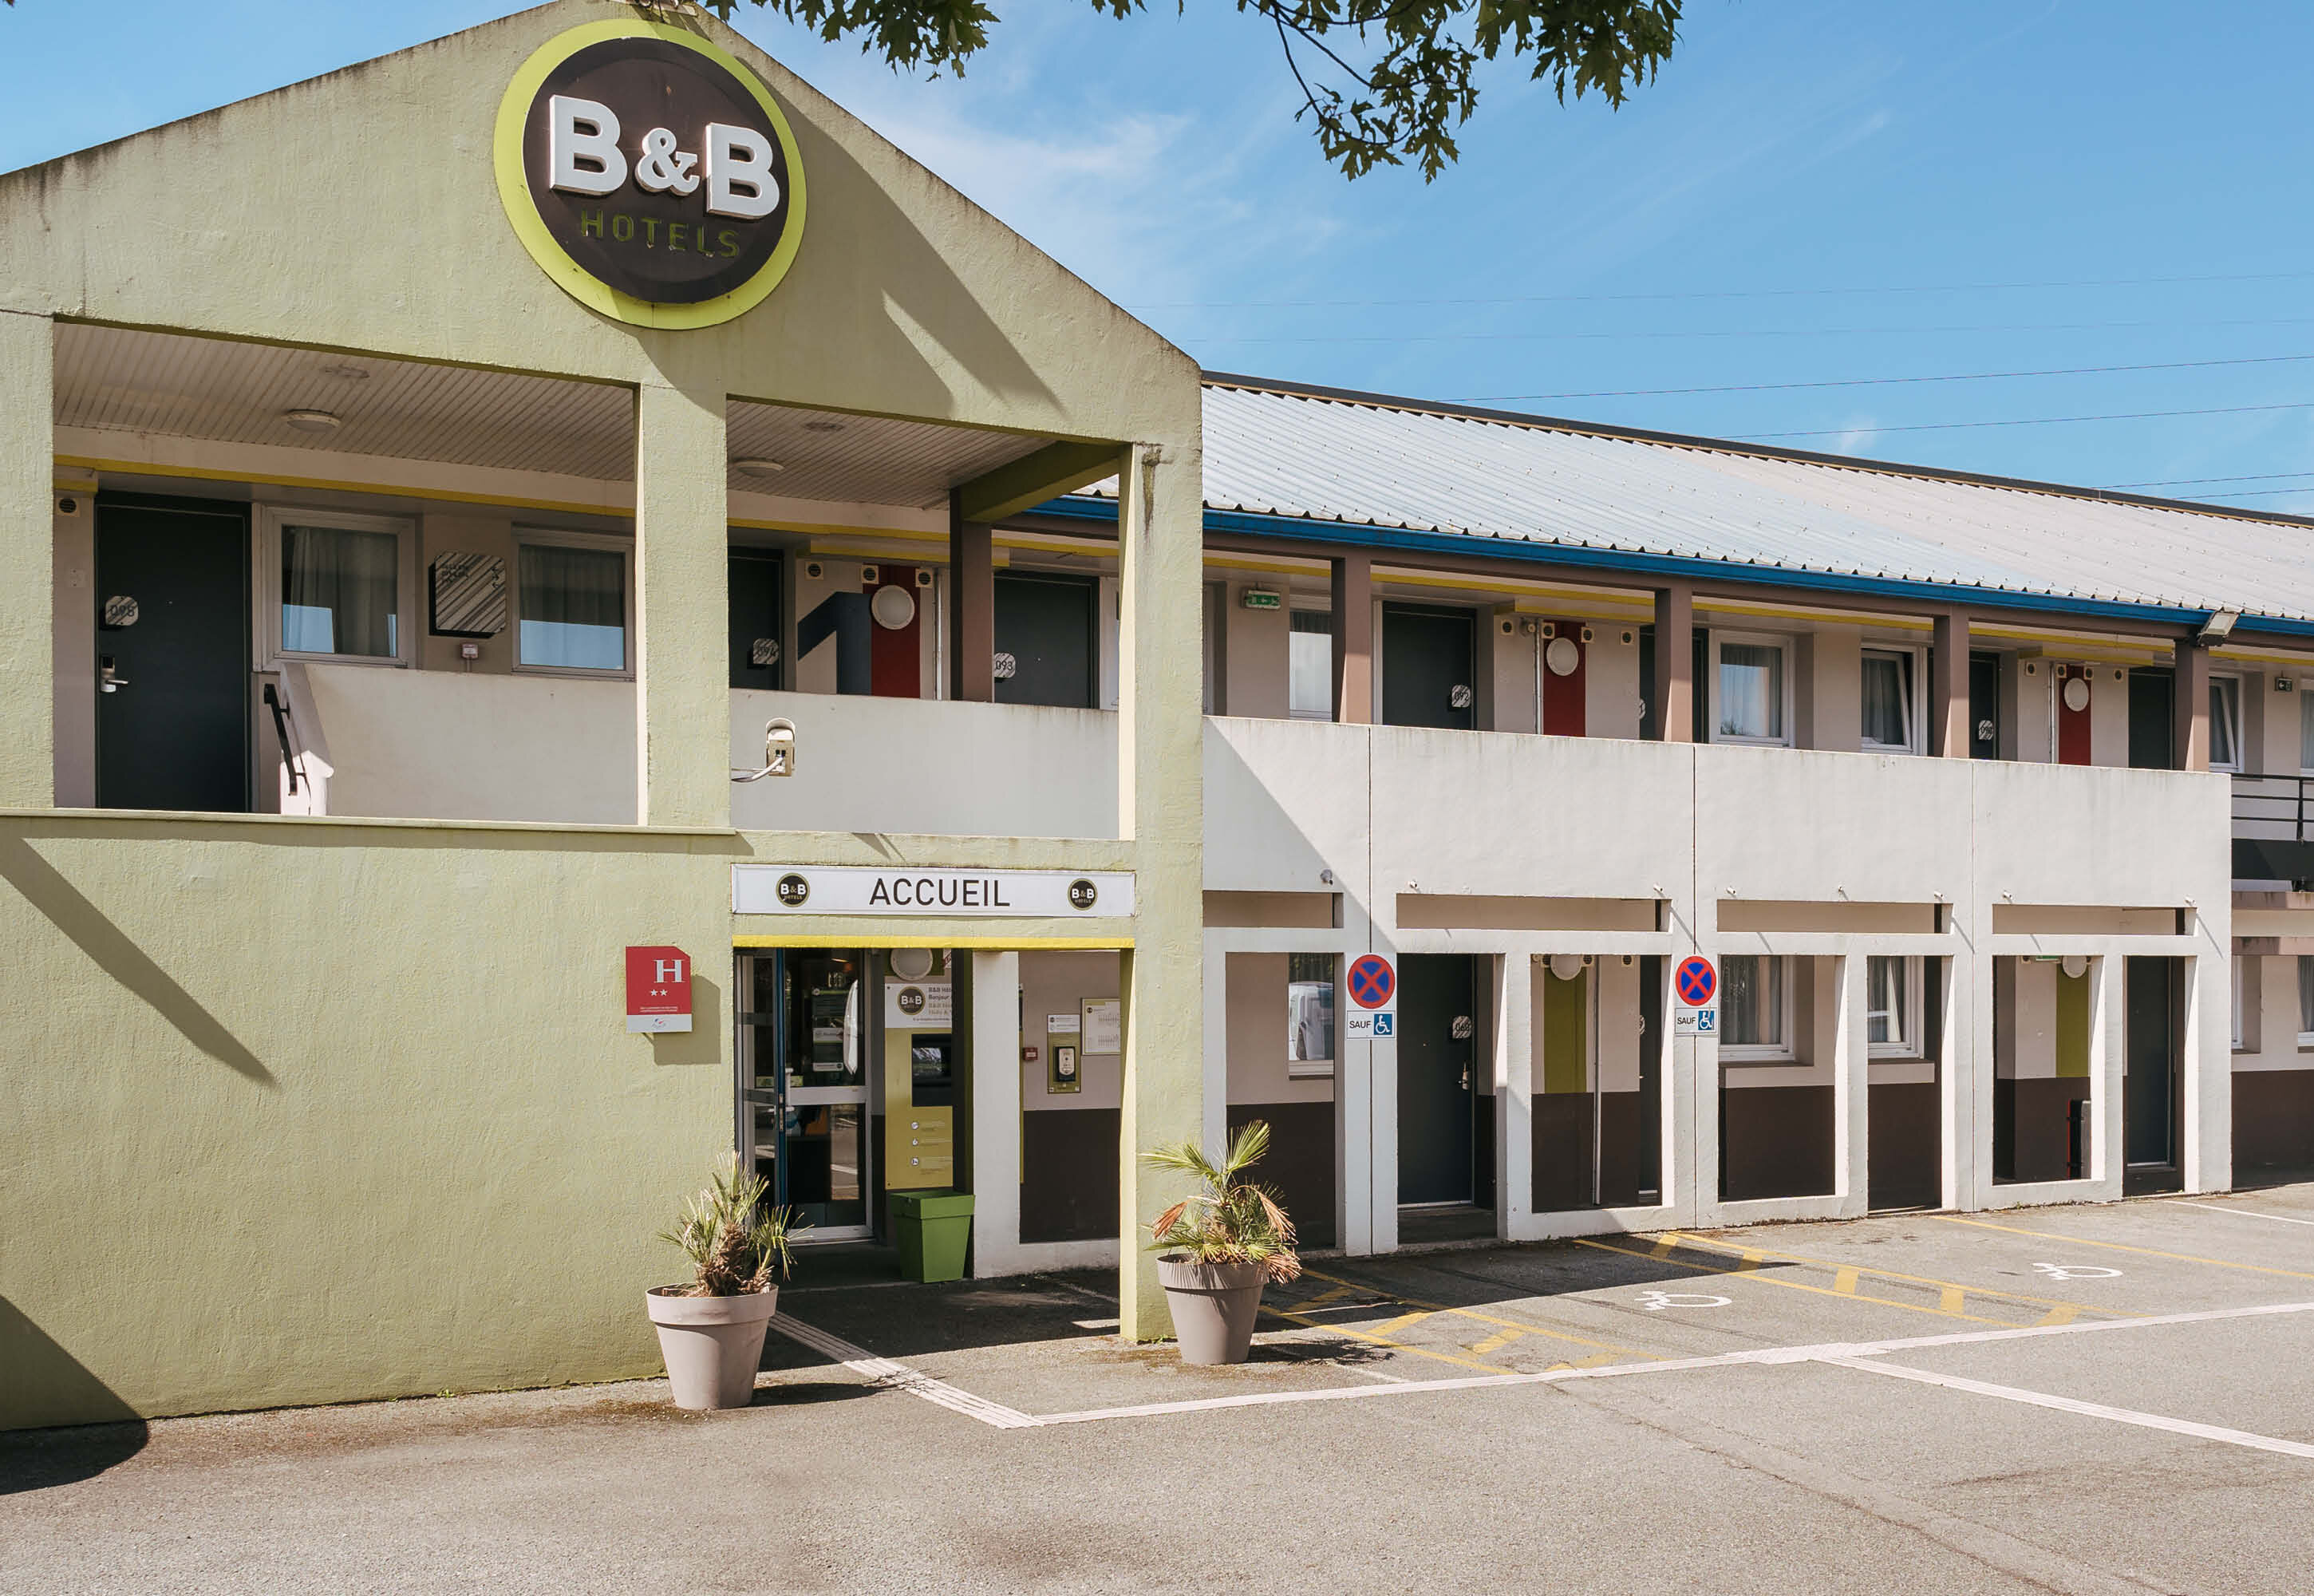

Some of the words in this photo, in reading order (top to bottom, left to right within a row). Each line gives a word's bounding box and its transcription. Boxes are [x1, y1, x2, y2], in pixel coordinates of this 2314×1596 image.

[549, 94, 780, 220] B&B
[580, 209, 741, 258] HOTELS
[995, 660, 1013, 671] 093
[780, 883, 806, 895] B&B
[868, 877, 1011, 907] ACCUEIL
[1072, 888, 1095, 899] B&B
[654, 958, 686, 983] H
[901, 995, 922, 1005] B&B
[1349, 1020, 1372, 1029] SAUF
[1677, 1017, 1696, 1025] SAUF
